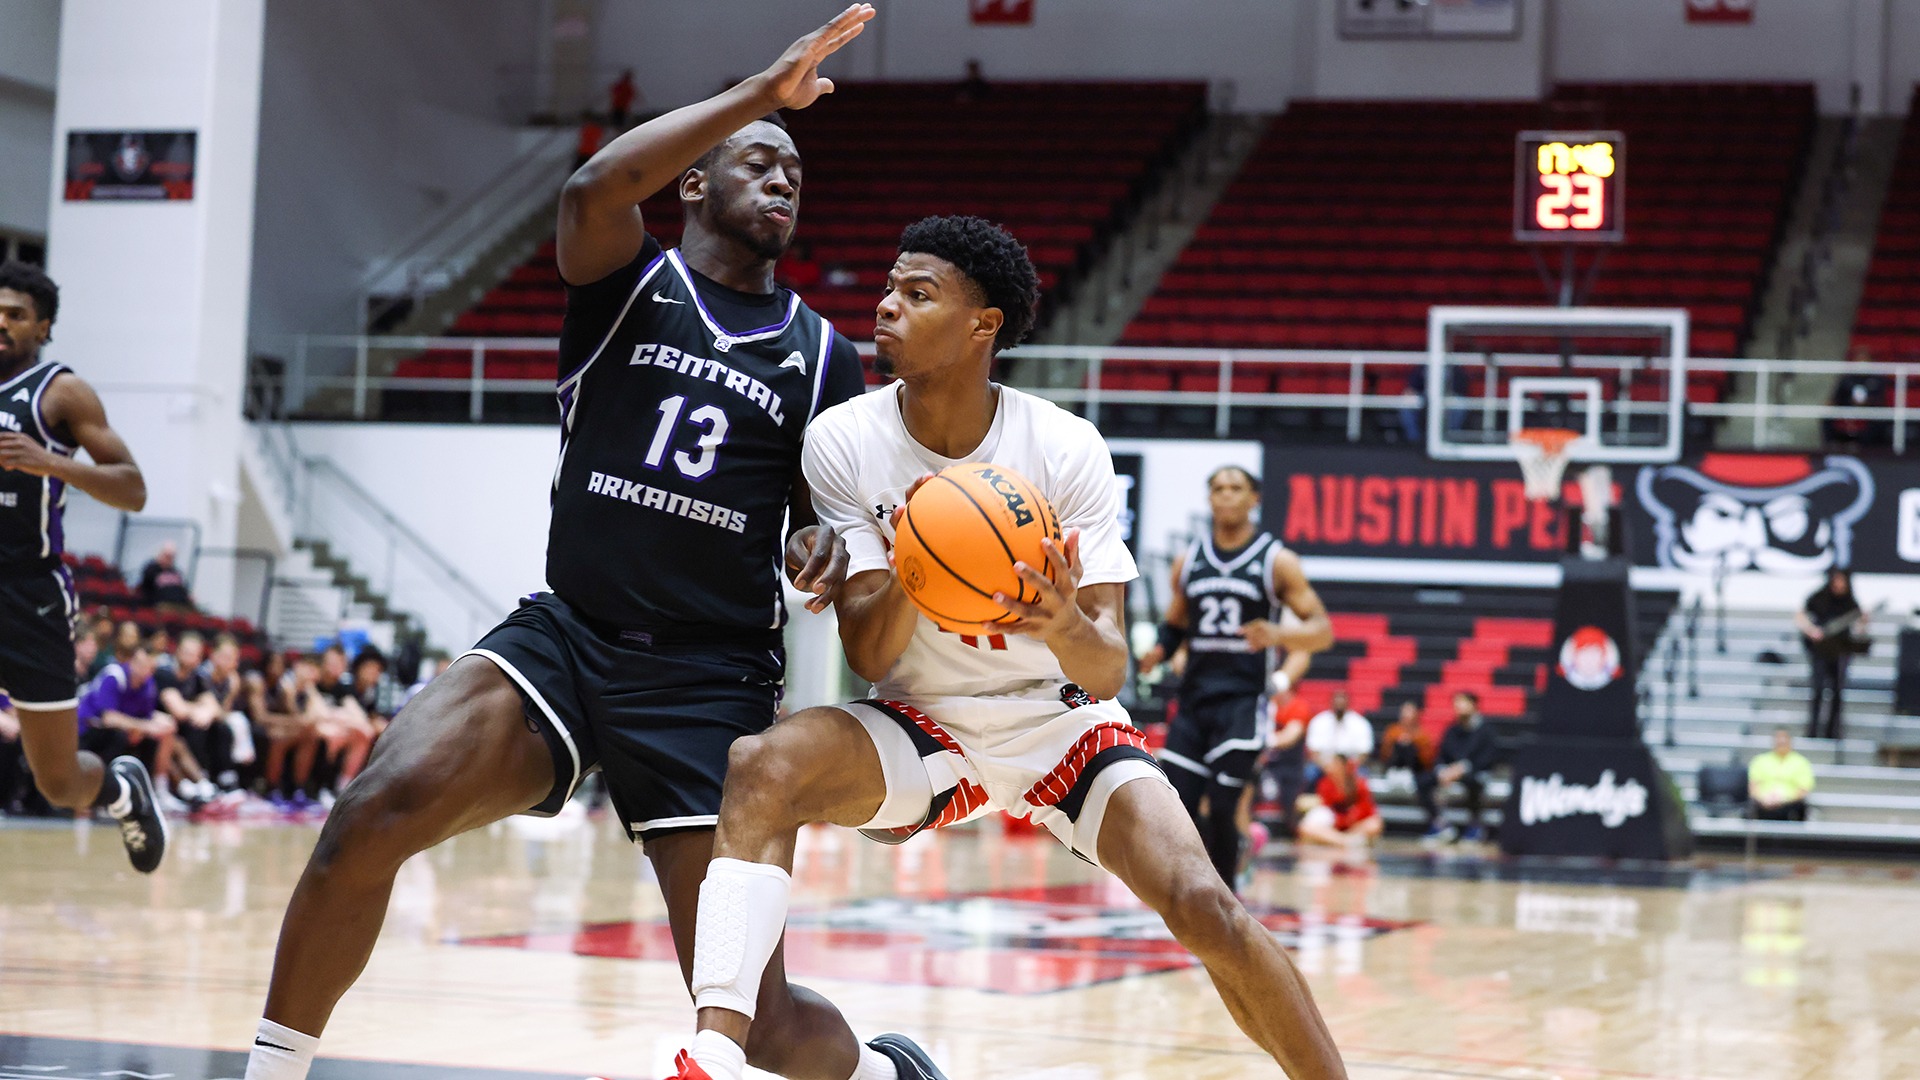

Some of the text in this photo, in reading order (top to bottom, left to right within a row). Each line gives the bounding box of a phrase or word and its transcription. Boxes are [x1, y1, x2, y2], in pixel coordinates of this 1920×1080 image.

[1536, 173, 1604, 230] 23
[629, 343, 785, 427] CENTRAL
[643, 393, 731, 481] 13
[587, 471, 747, 533] ARKANSAS
[973, 468, 1035, 528] NCAA
[1283, 473, 1478, 548] AUSTIN
[1199, 596, 1241, 635] 23
[1519, 768, 1648, 828] Wendy's
